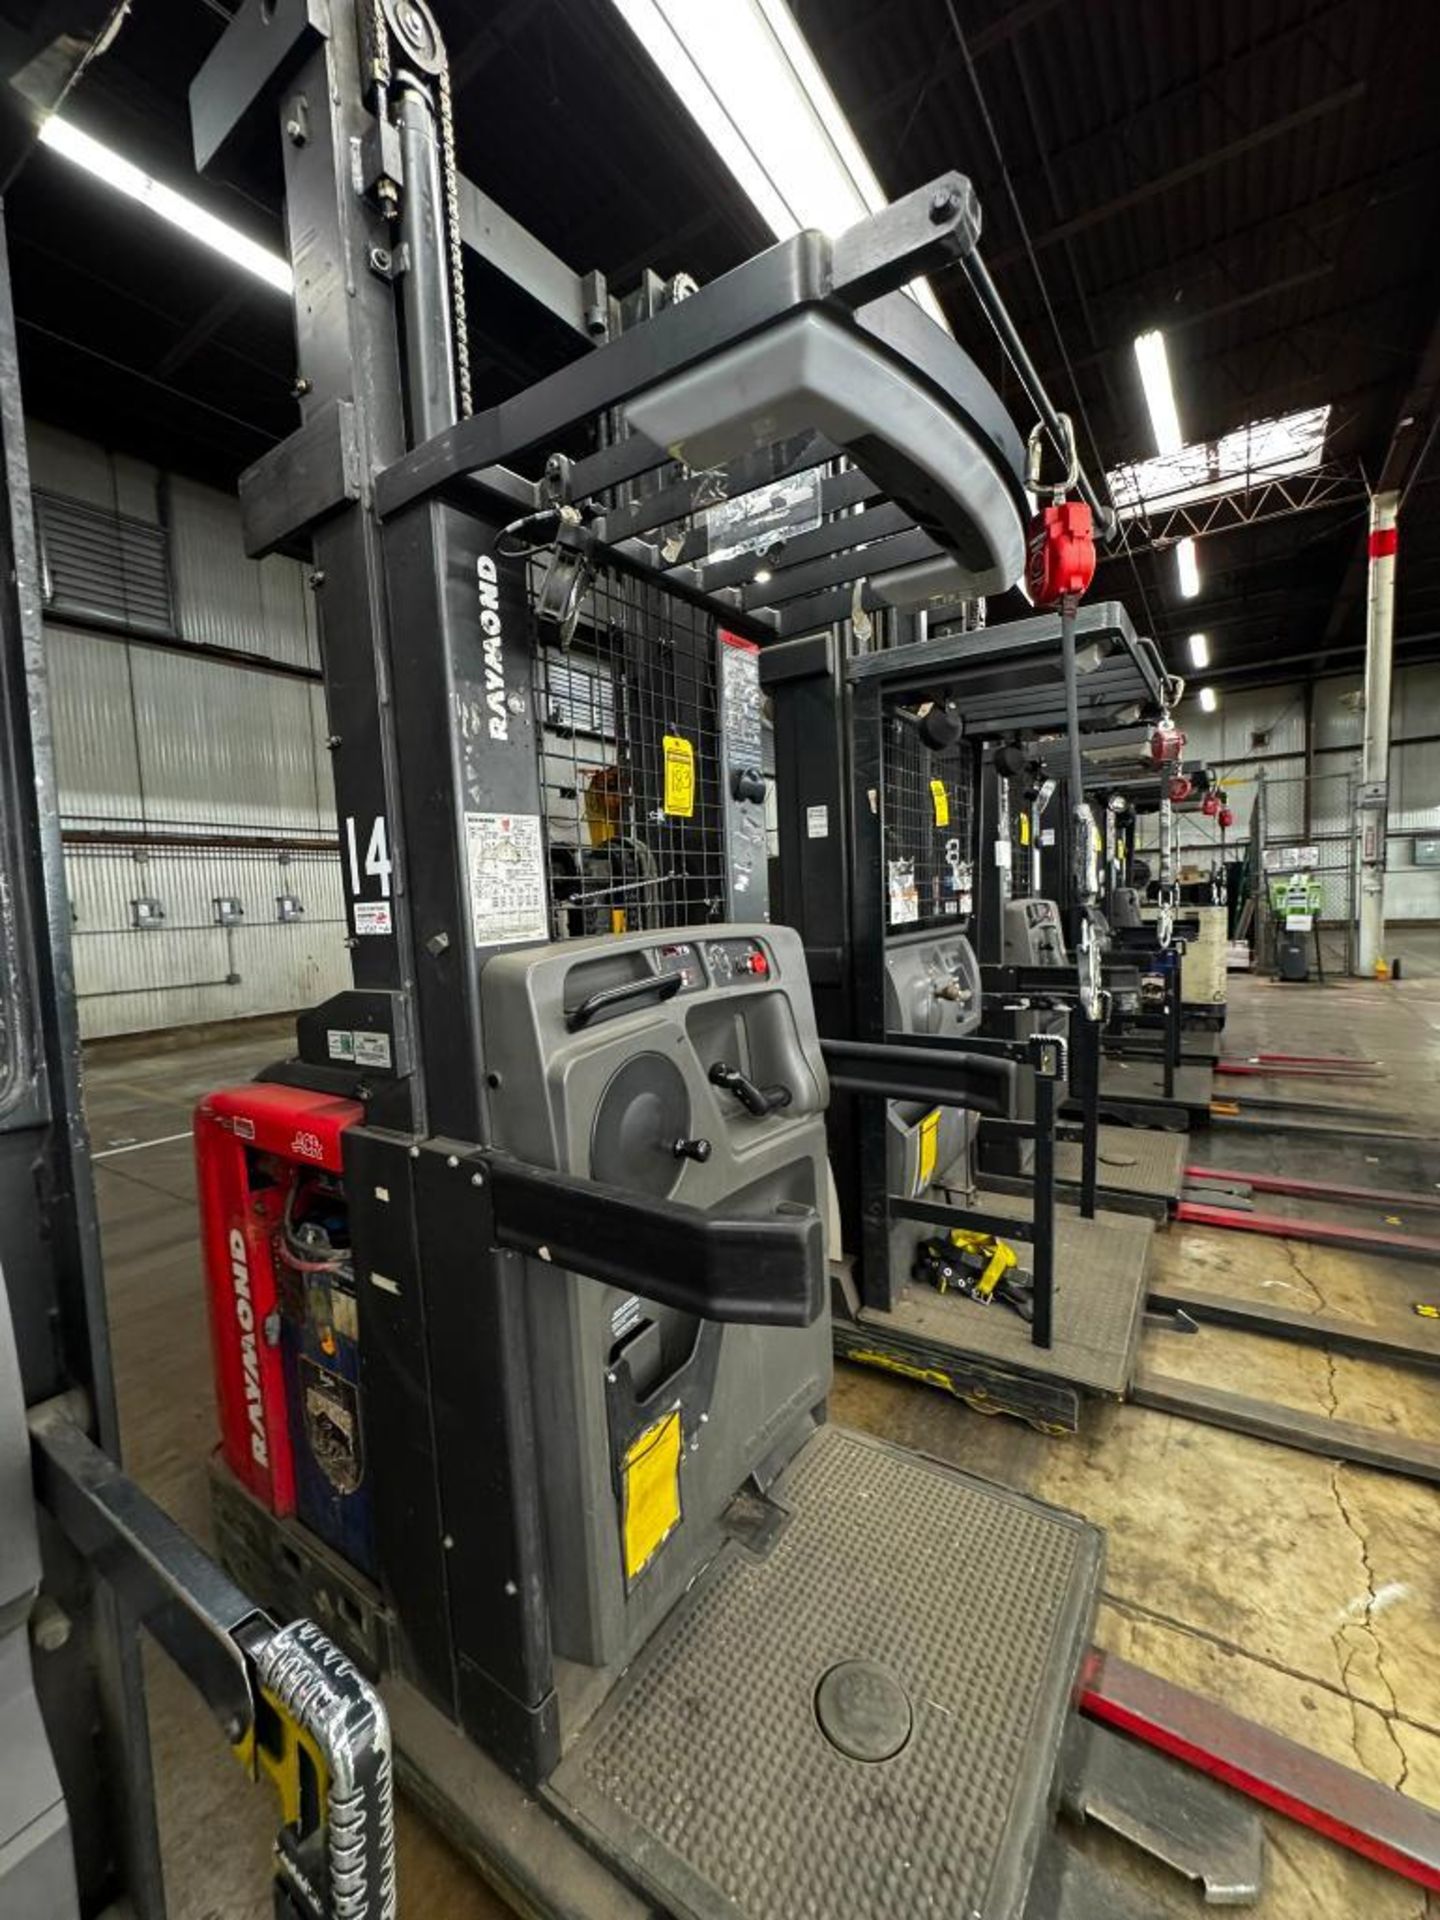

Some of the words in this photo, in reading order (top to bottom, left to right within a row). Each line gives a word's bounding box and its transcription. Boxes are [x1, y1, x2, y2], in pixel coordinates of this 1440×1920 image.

[477, 555, 508, 741] RAYMOND
[346, 816, 392, 897] 14
[229, 1228, 269, 1468] RAYMOND
